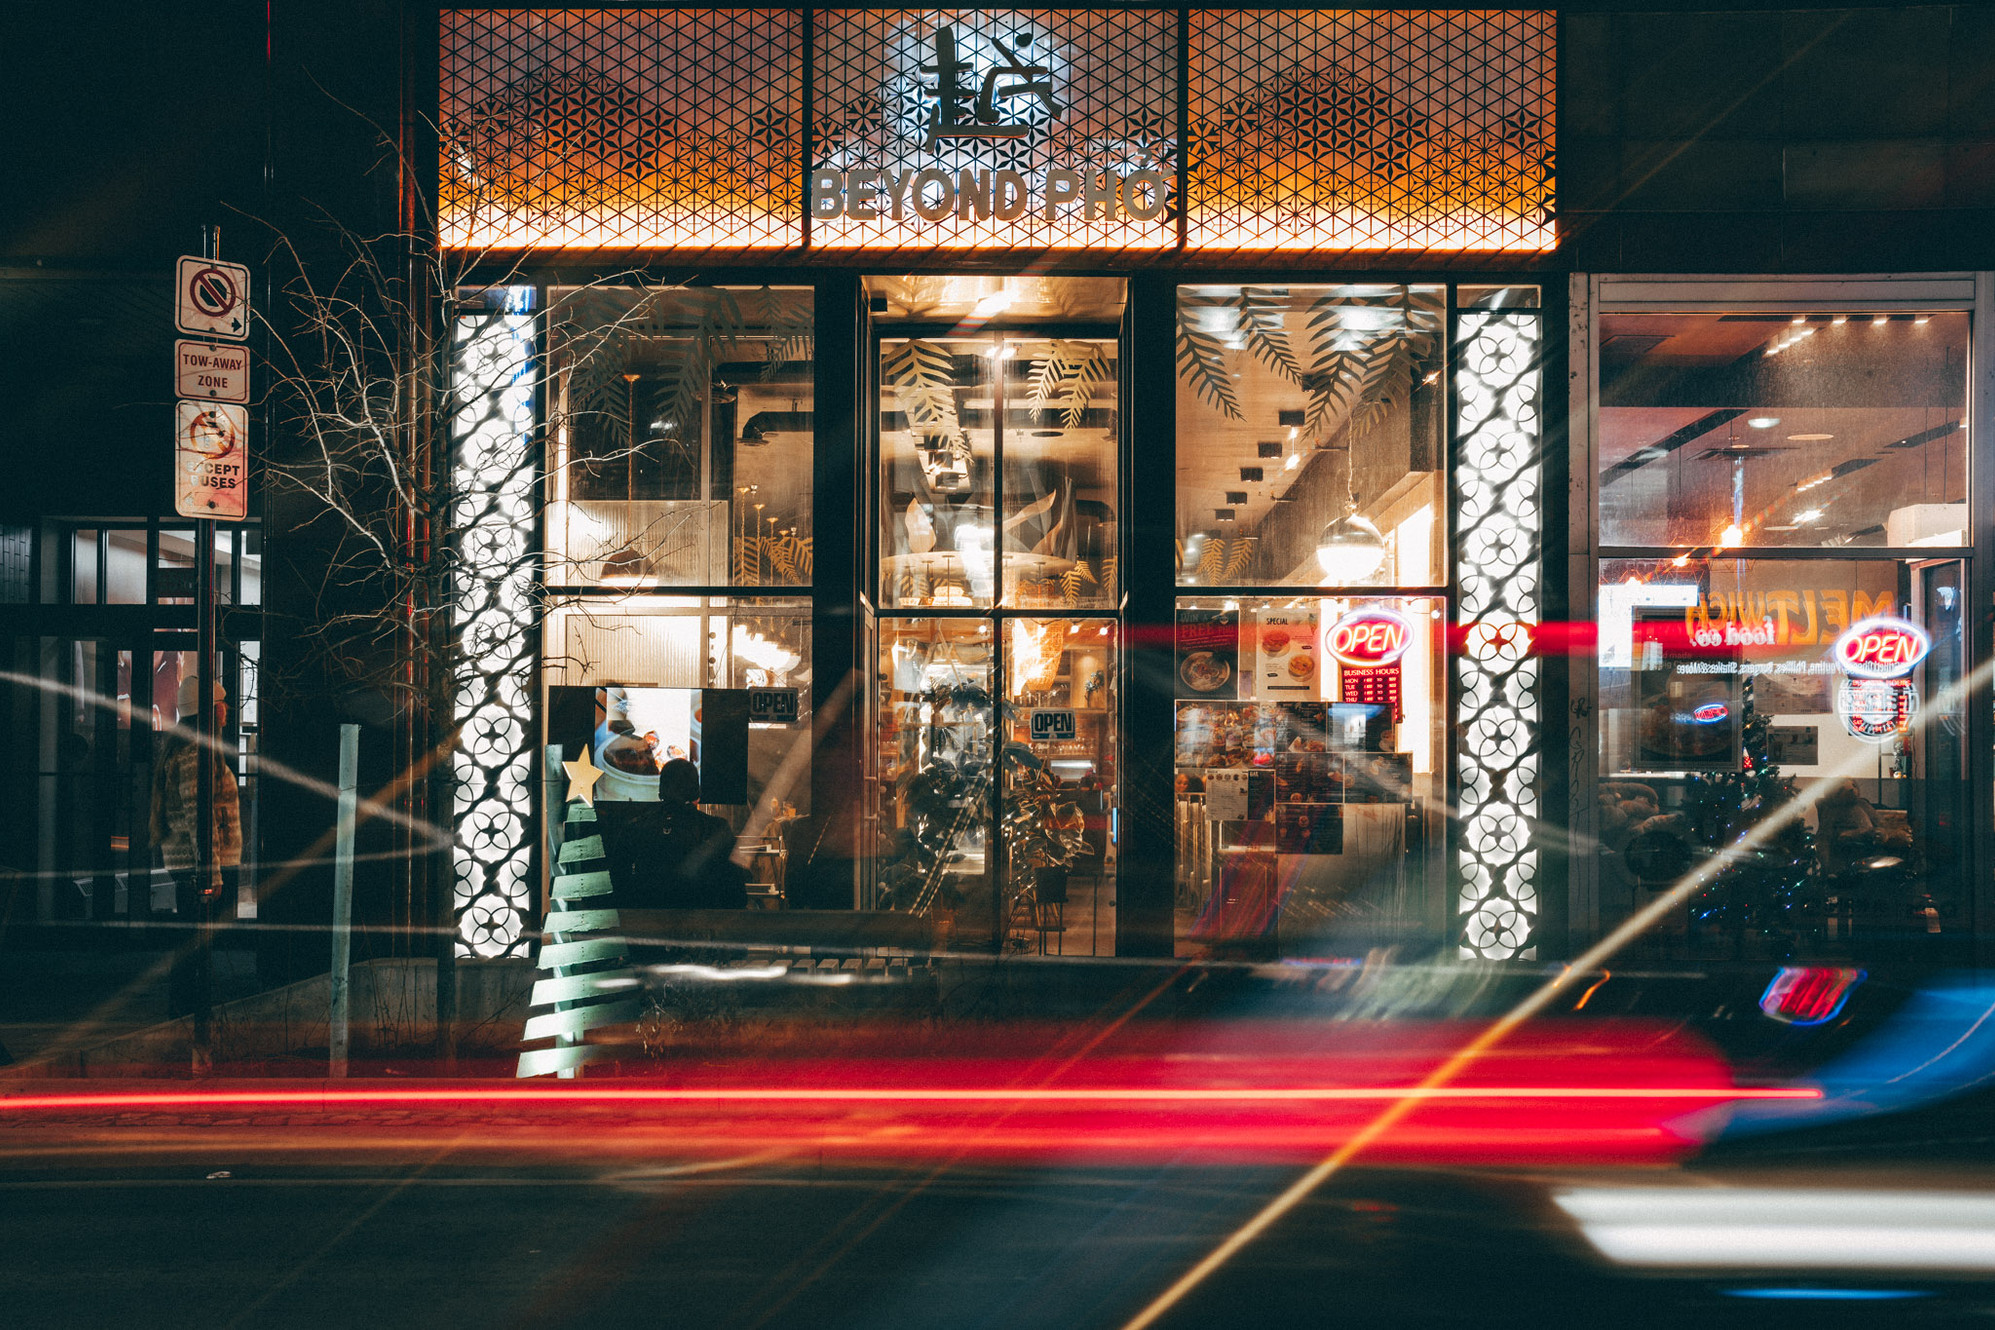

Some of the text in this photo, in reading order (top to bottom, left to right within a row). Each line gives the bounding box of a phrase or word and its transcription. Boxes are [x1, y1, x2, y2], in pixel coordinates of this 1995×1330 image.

[811, 168, 1028, 222] BEYOND
[183, 353, 242, 370] TOW-AWAY
[198, 375, 228, 388] ZONE
[1266, 617, 1288, 626] SPECIAL
[1333, 624, 1405, 653] OPEN
[1844, 635, 1918, 663] OPEN
[1375, 667, 1399, 675] HOURS
[753, 692, 794, 713] OPEN
[1034, 713, 1072, 731] OPEN
